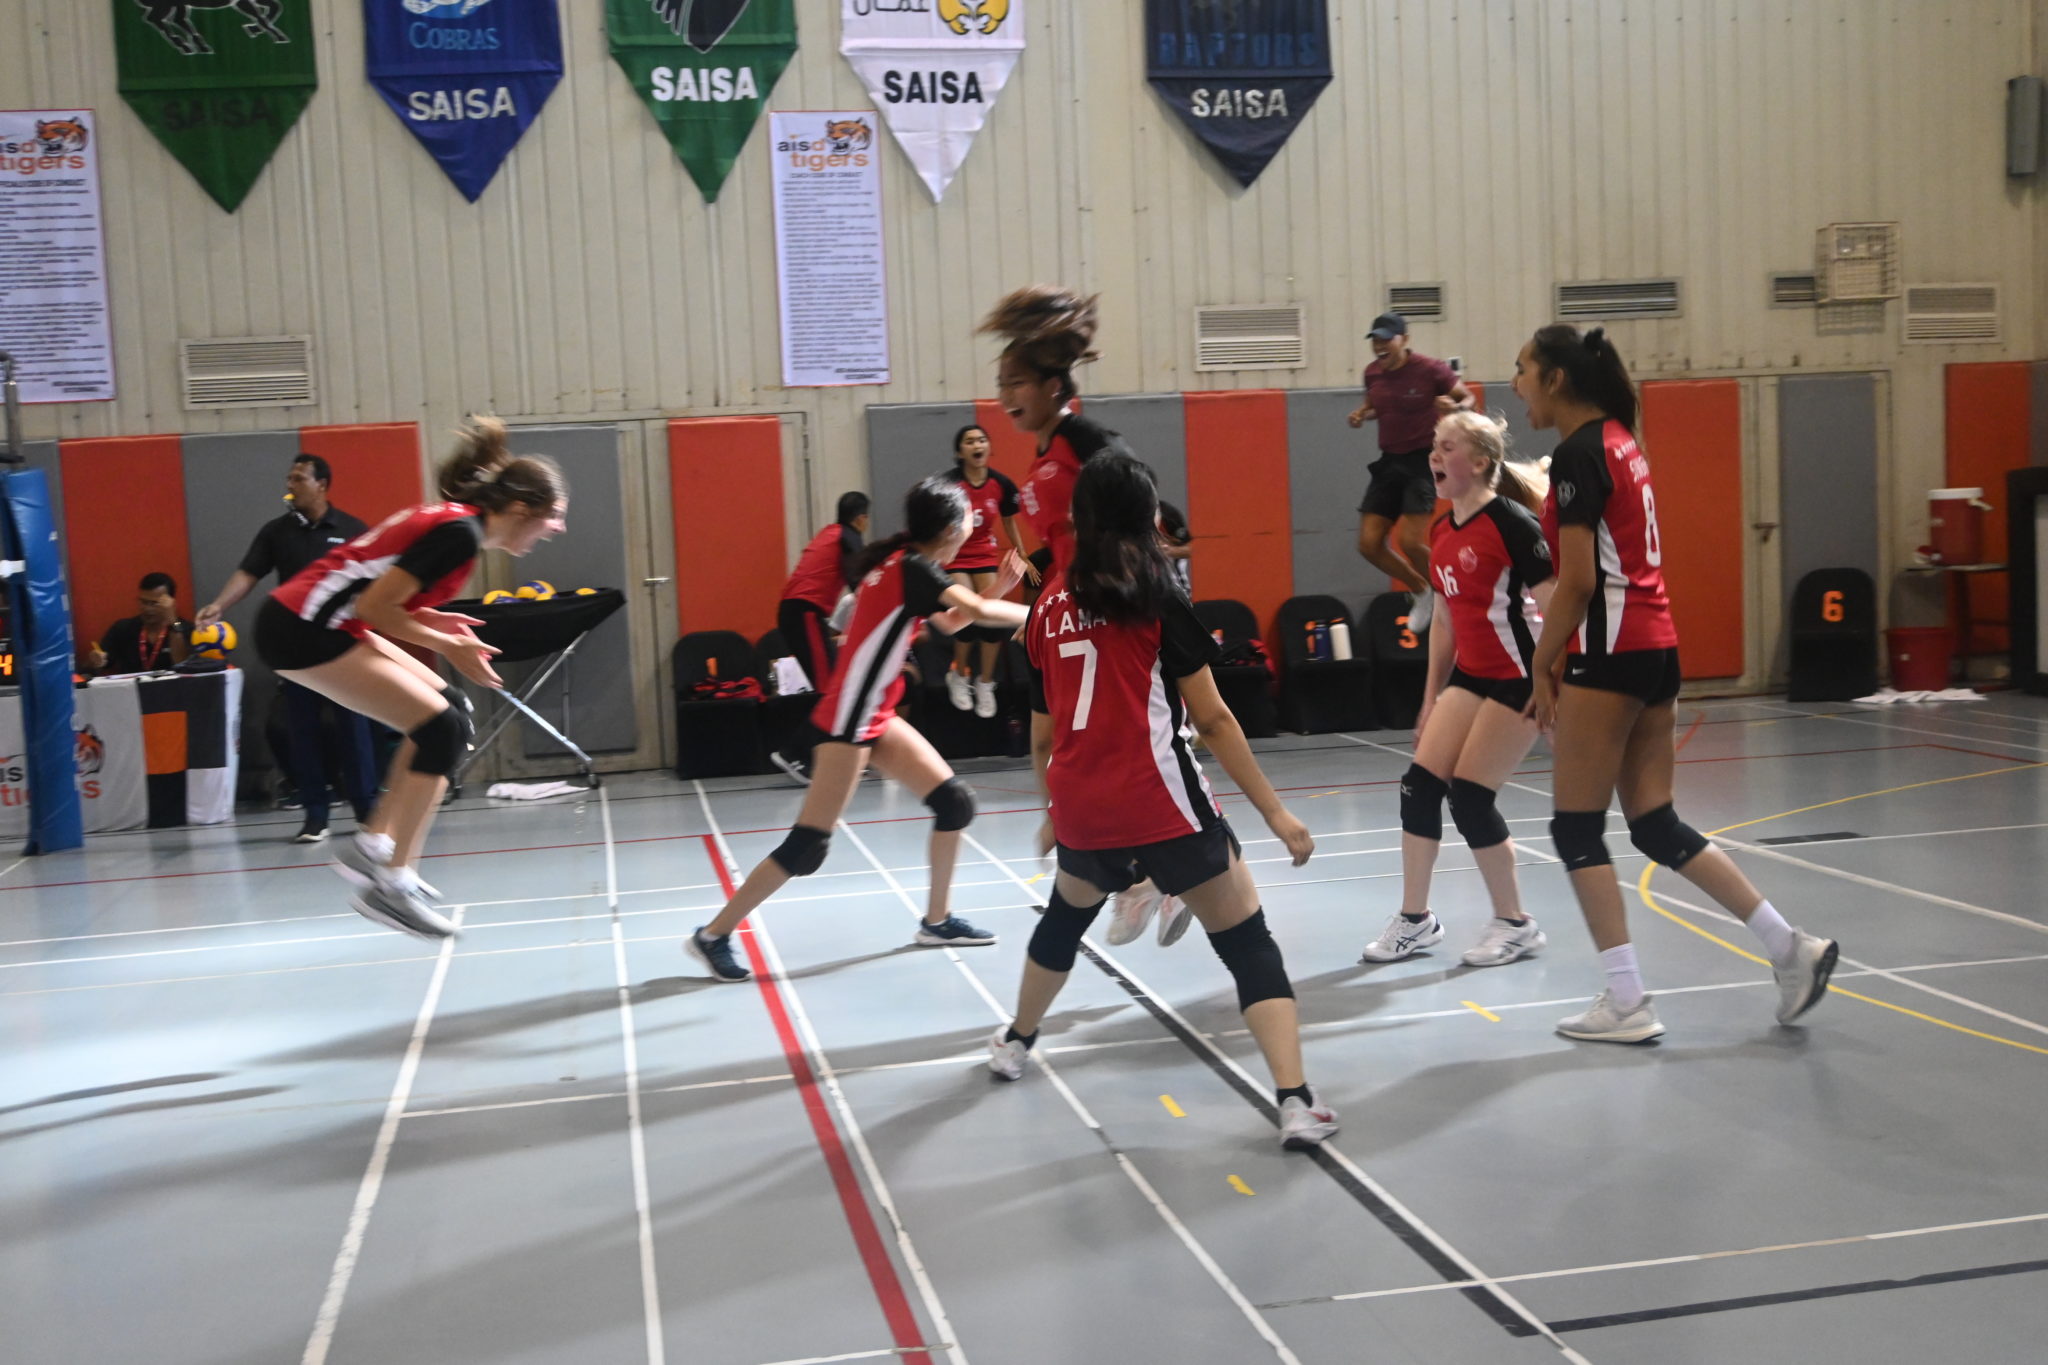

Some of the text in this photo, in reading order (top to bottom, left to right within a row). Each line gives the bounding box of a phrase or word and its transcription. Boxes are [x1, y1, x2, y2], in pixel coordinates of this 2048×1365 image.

[408, 21, 501, 50] COBRAS
[651, 66, 759, 102] SAISA
[884, 70, 984, 104] SAISA
[164, 97, 274, 130] SAISA
[408, 86, 517, 121] SAISA
[1191, 88, 1289, 119] SAISA
[790, 151, 870, 172] tigers
[1435, 564, 1460, 599] 16
[1821, 590, 1845, 622] 6
[1058, 639, 1098, 731] 7
